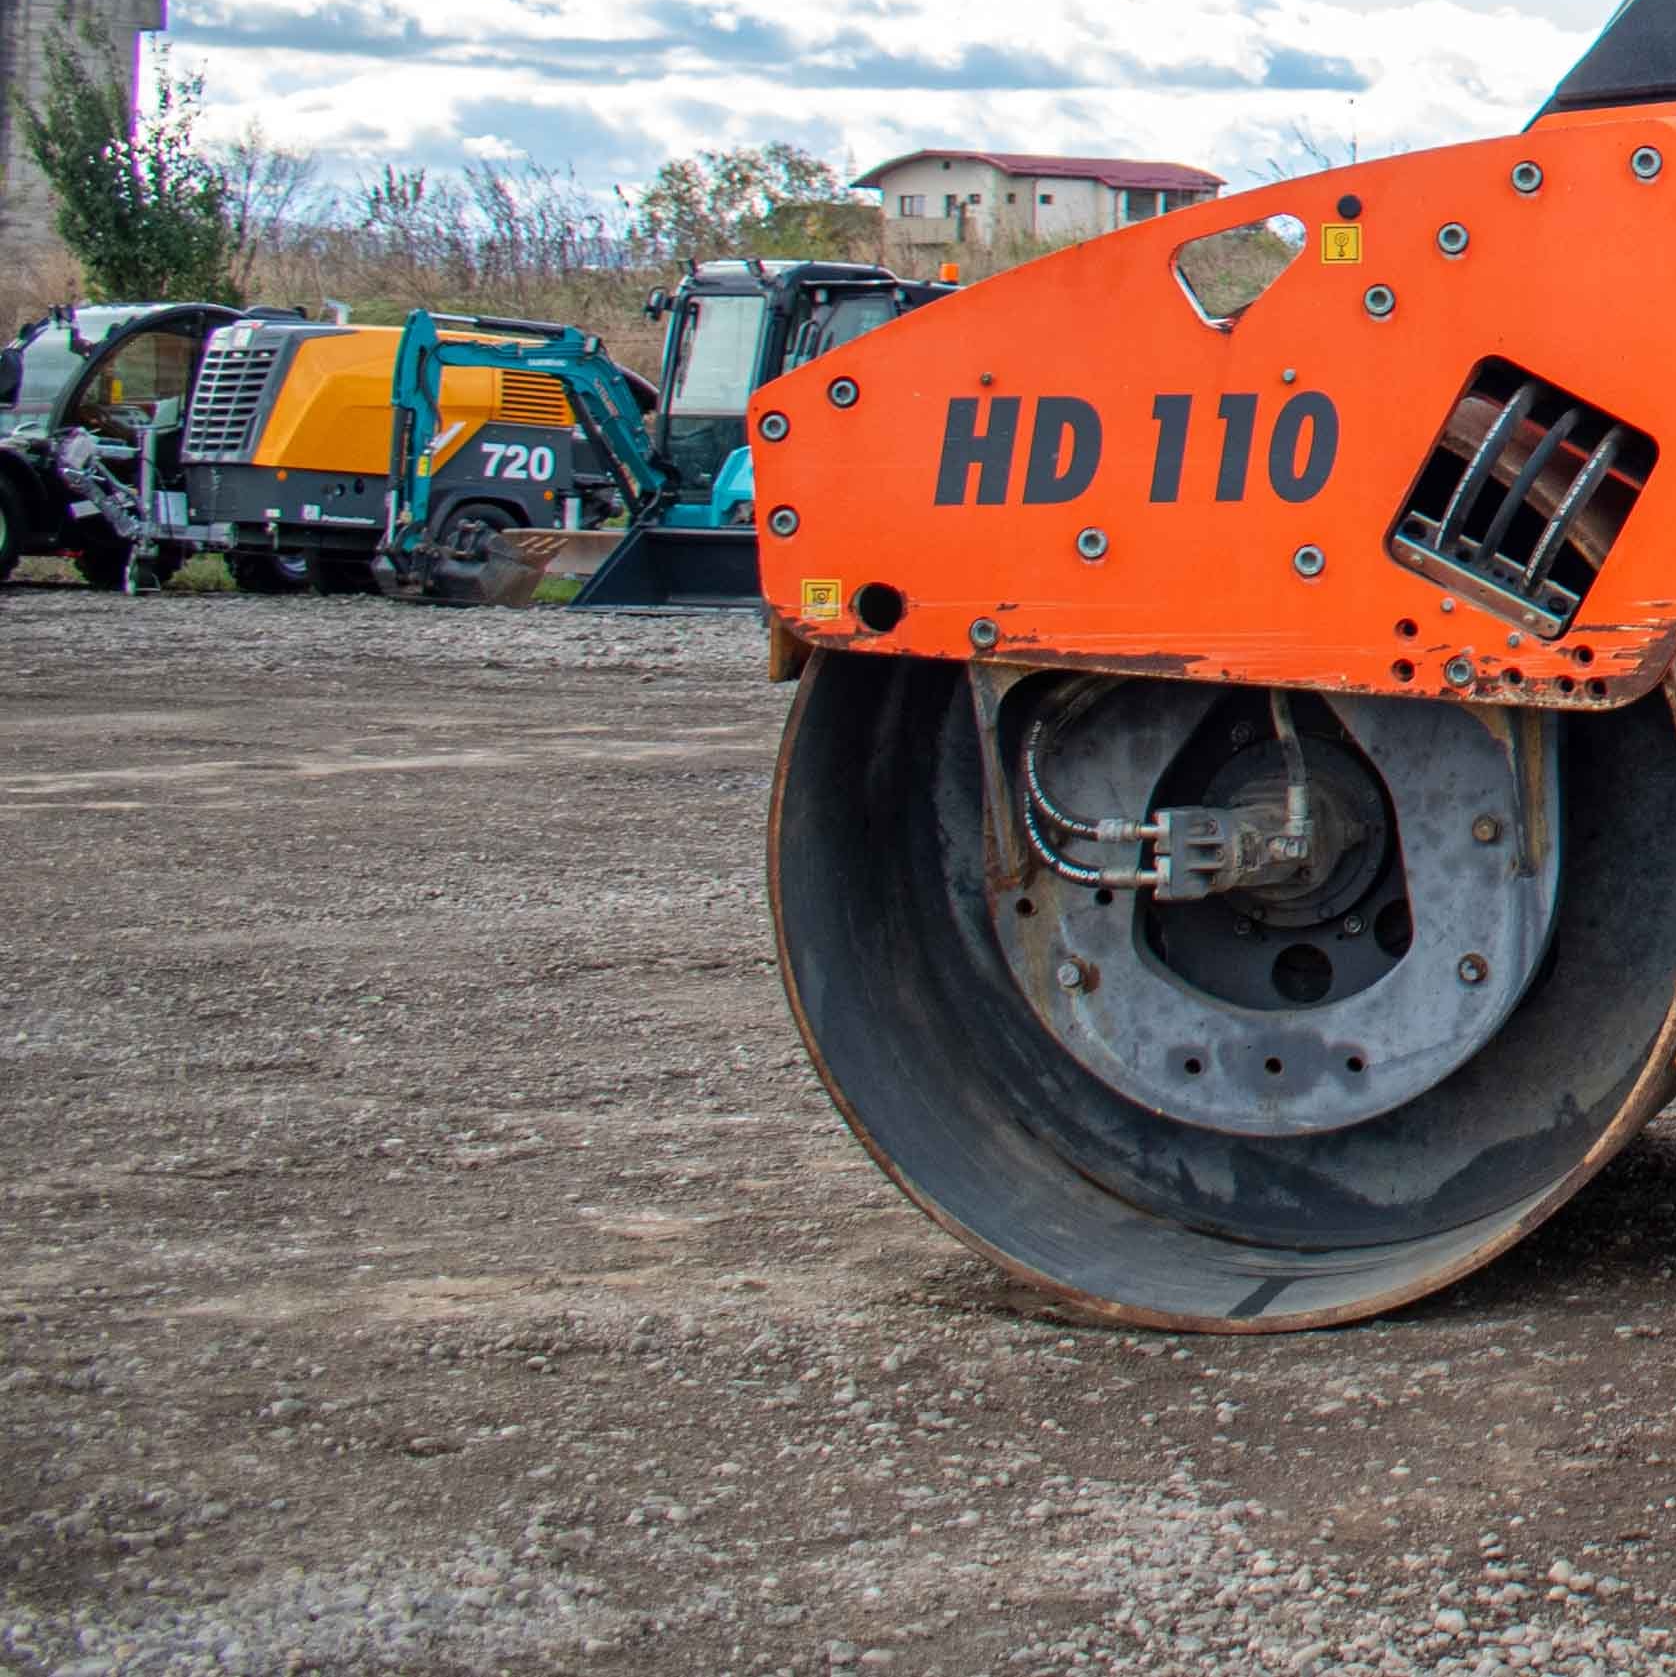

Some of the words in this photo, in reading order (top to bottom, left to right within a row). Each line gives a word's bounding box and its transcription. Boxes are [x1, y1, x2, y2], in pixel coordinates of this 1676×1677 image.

[480, 442, 556, 482] 720
[933, 395, 1103, 506] HD
[1149, 390, 1340, 504] 110
